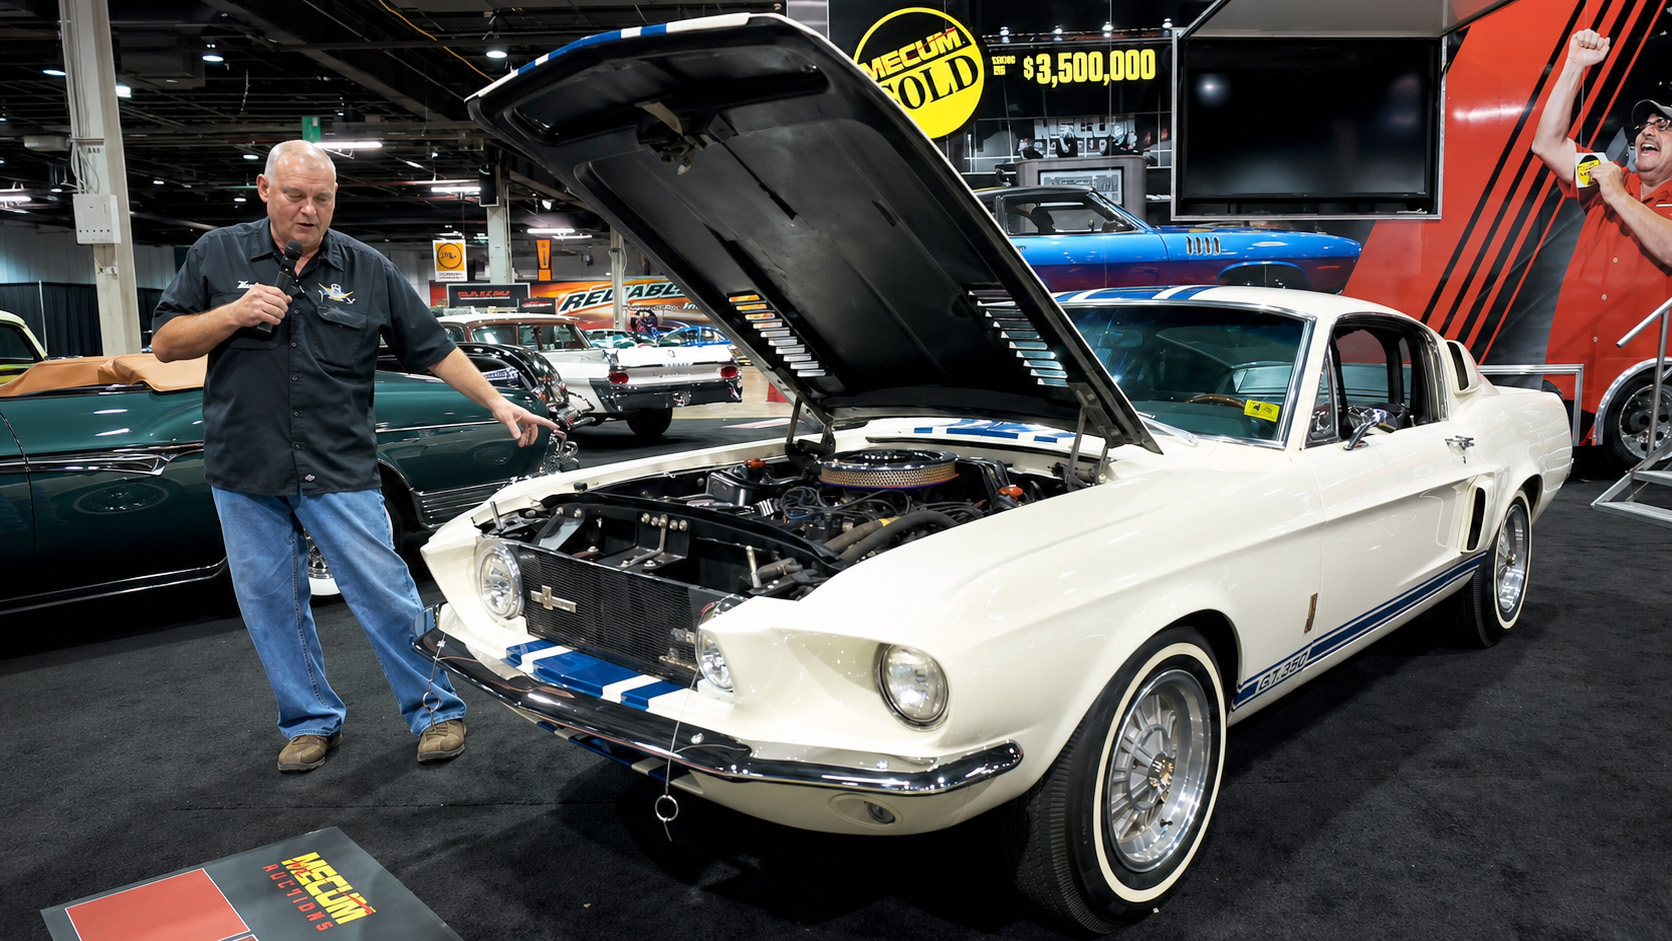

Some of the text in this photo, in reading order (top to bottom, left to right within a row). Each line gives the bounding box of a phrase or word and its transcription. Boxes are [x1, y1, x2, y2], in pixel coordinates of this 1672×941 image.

[1023, 49, 1157, 88] $3,500,000
[263, 863, 334, 931] AUCTIONS
[281, 852, 376, 925] MECUM
